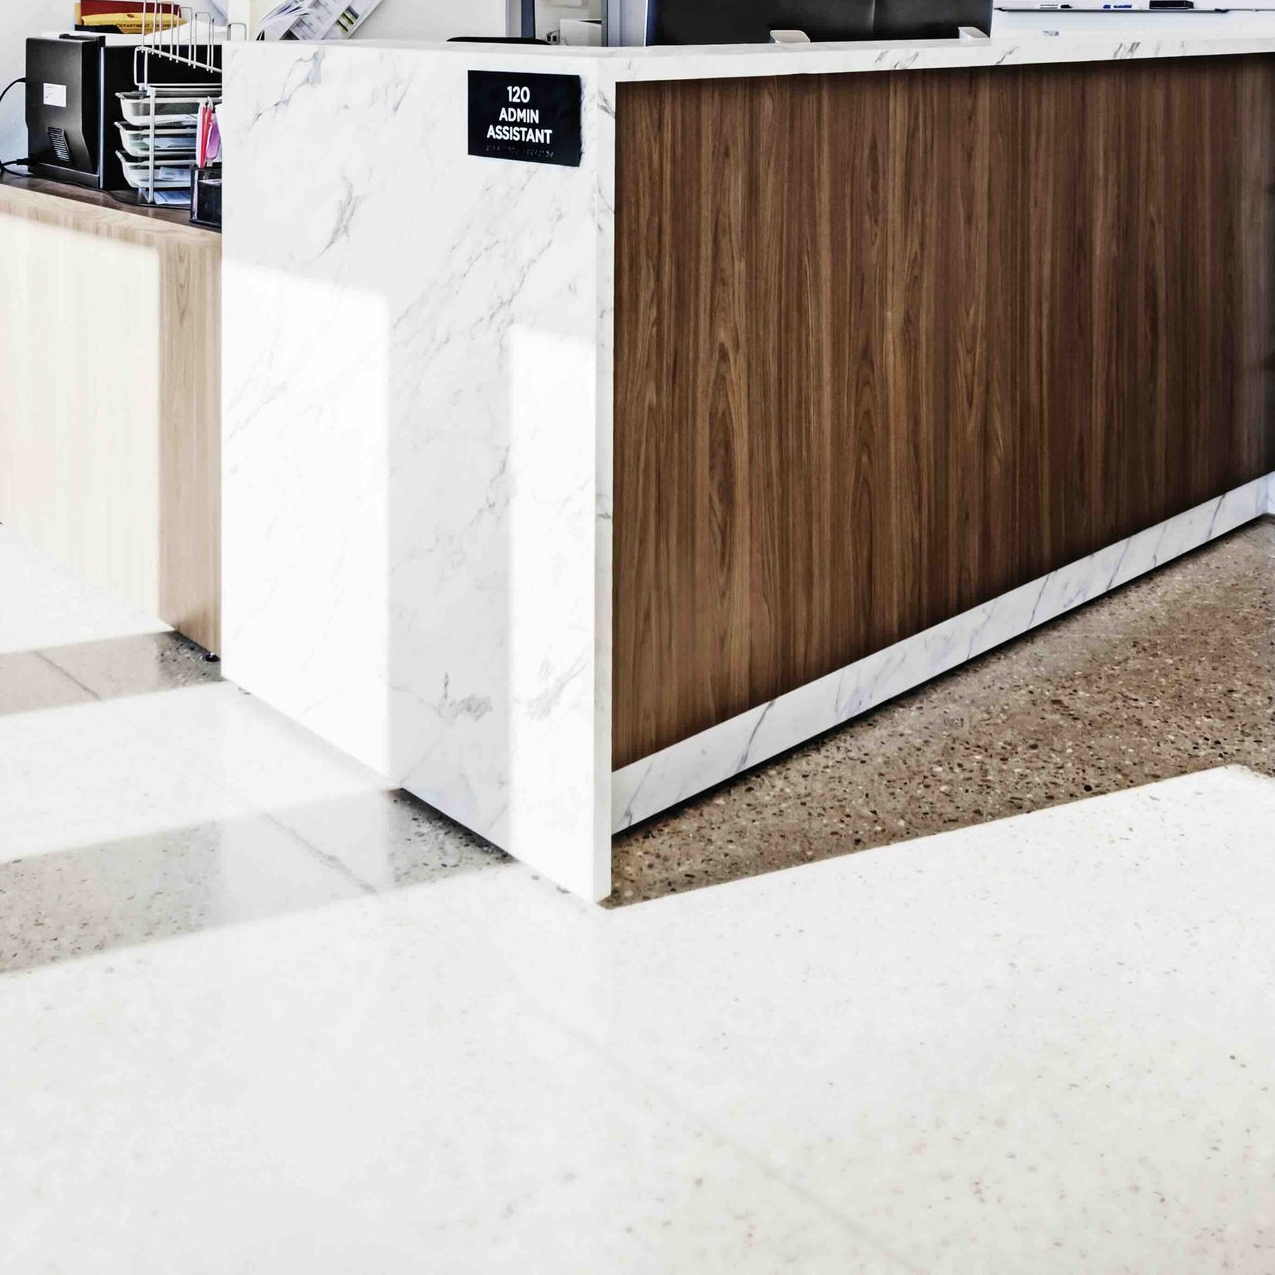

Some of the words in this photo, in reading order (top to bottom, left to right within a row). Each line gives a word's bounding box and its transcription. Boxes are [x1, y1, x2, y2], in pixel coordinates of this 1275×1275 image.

[507, 86, 531, 103] 120
[499, 107, 540, 124] ADMIN
[486, 125, 553, 144] ASSISTANT
